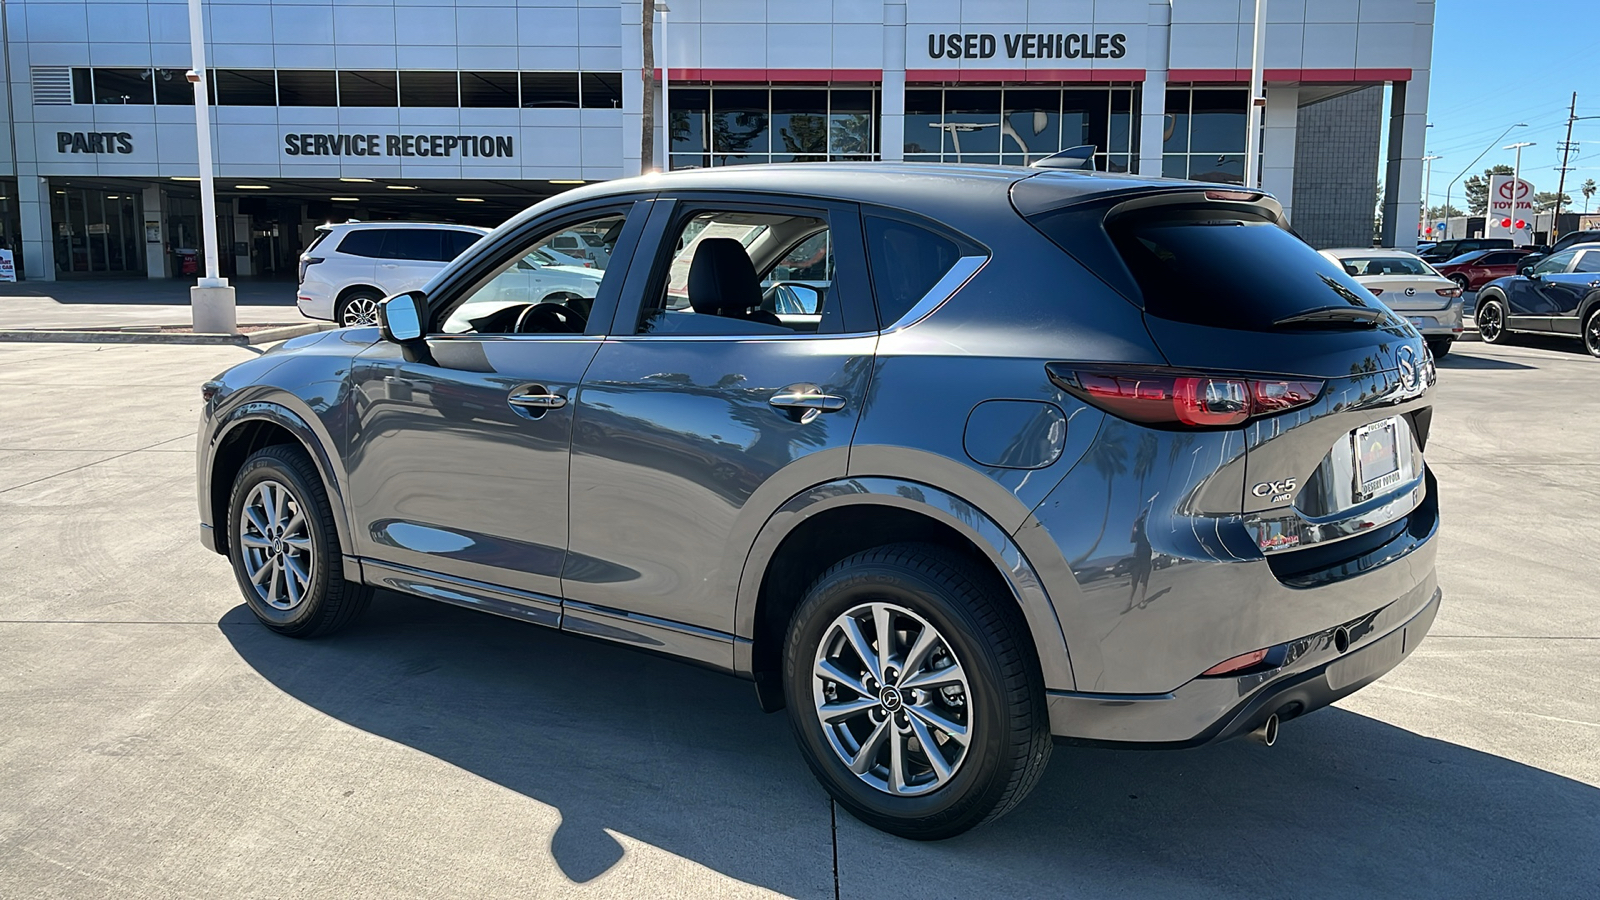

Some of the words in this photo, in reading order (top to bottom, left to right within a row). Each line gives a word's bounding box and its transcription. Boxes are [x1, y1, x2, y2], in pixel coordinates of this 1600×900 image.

[928, 33, 996, 59] USED
[1003, 33, 1127, 59] VEHICLES
[57, 131, 133, 154] PARTS
[284, 133, 381, 156] SERVICE
[386, 134, 514, 158] RECEPTION
[1367, 421, 1388, 431] TUCSON
[1252, 477, 1297, 497] CX-5
[1271, 493, 1291, 503] AWD
